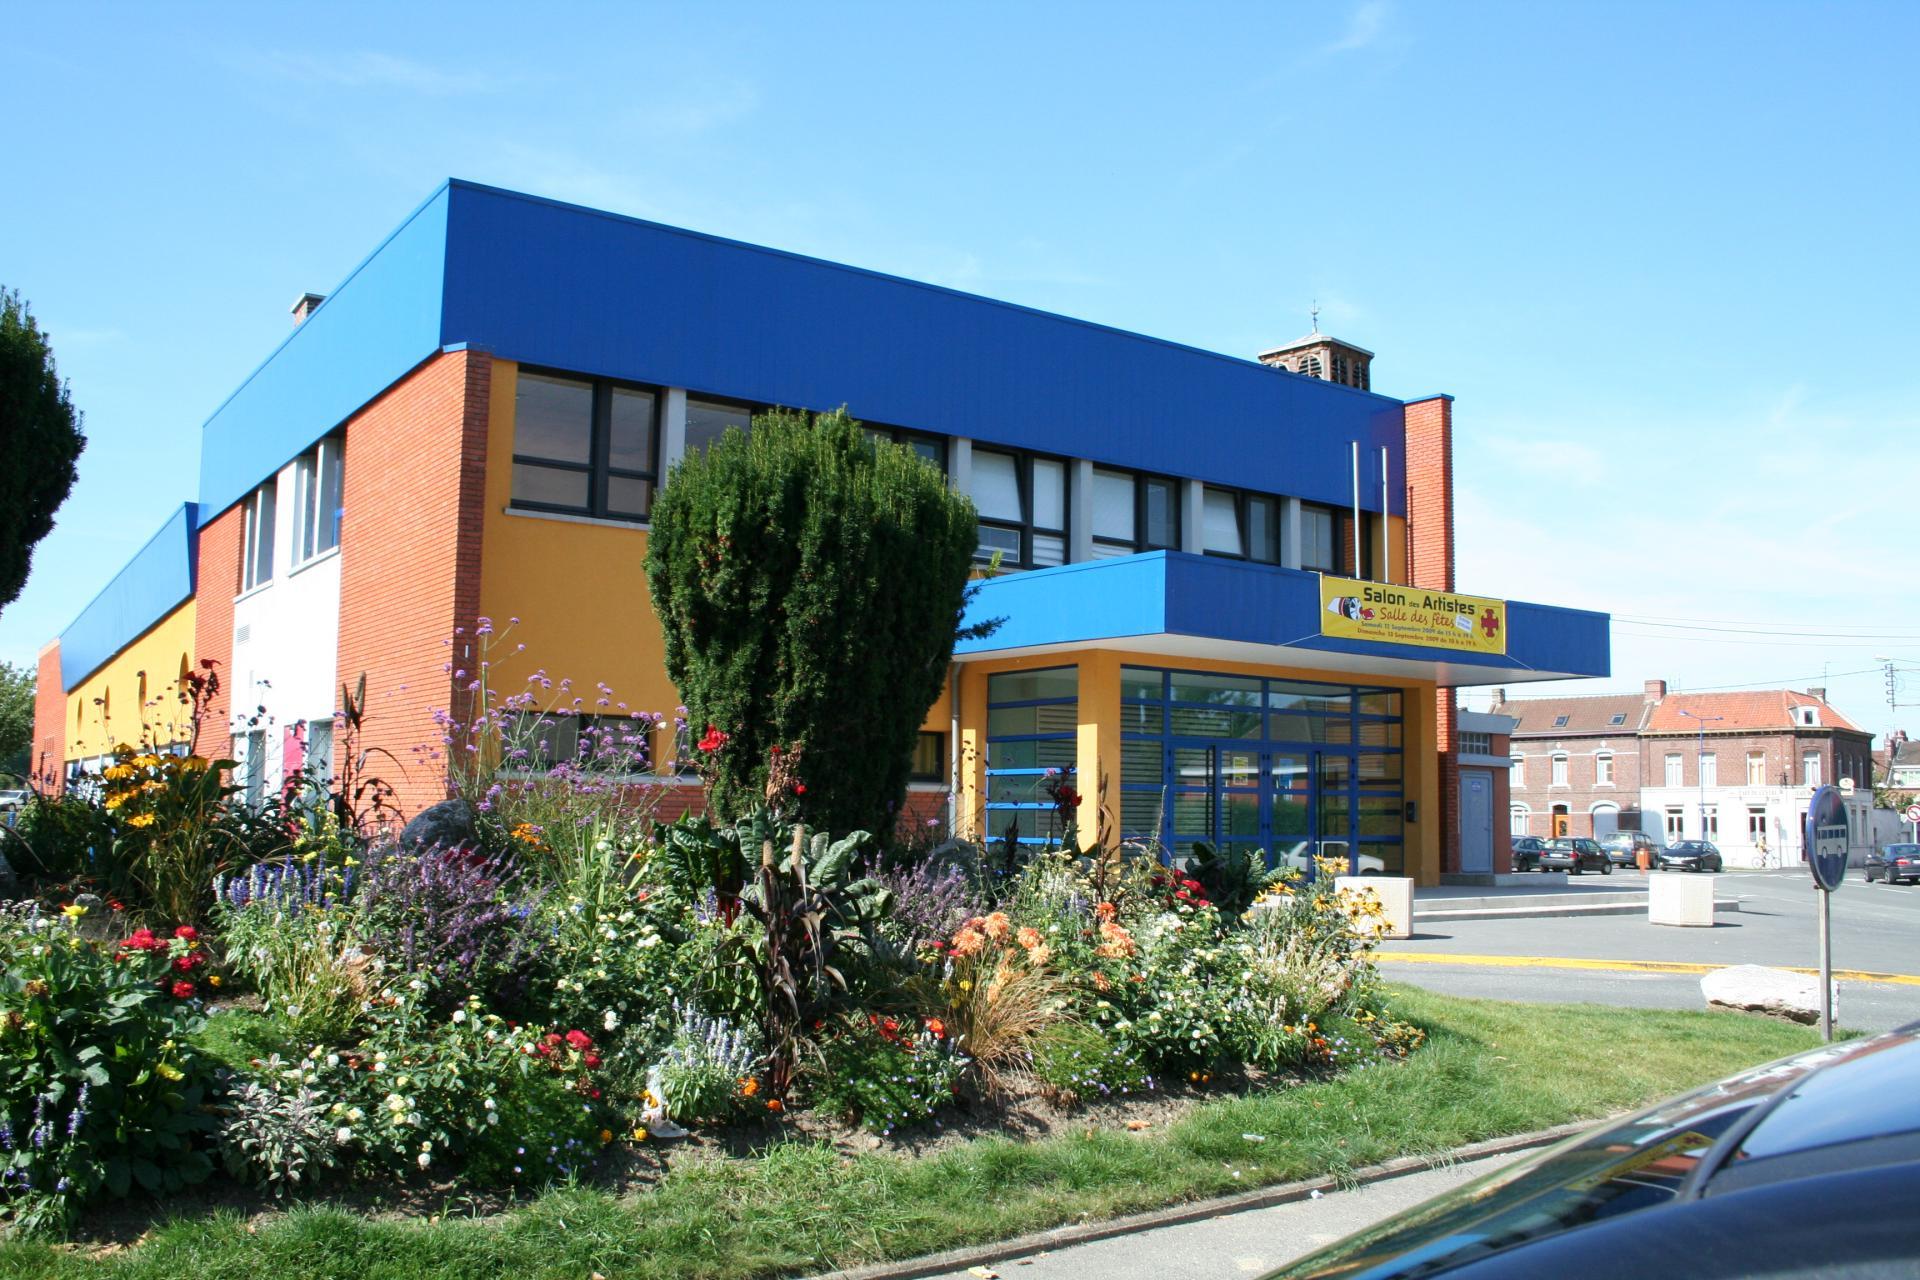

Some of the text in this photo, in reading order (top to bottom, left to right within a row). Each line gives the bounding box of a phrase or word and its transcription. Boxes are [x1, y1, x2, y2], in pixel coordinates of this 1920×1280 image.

[1364, 587, 1405, 606] Salon
[1423, 595, 1475, 615] Artistes
[1380, 606, 1408, 621] Salle
[1411, 609, 1428, 625] des
[1431, 612, 1454, 628] fêtes
[1357, 627, 1385, 636] Dimanche
[1395, 632, 1424, 640] Septembre
